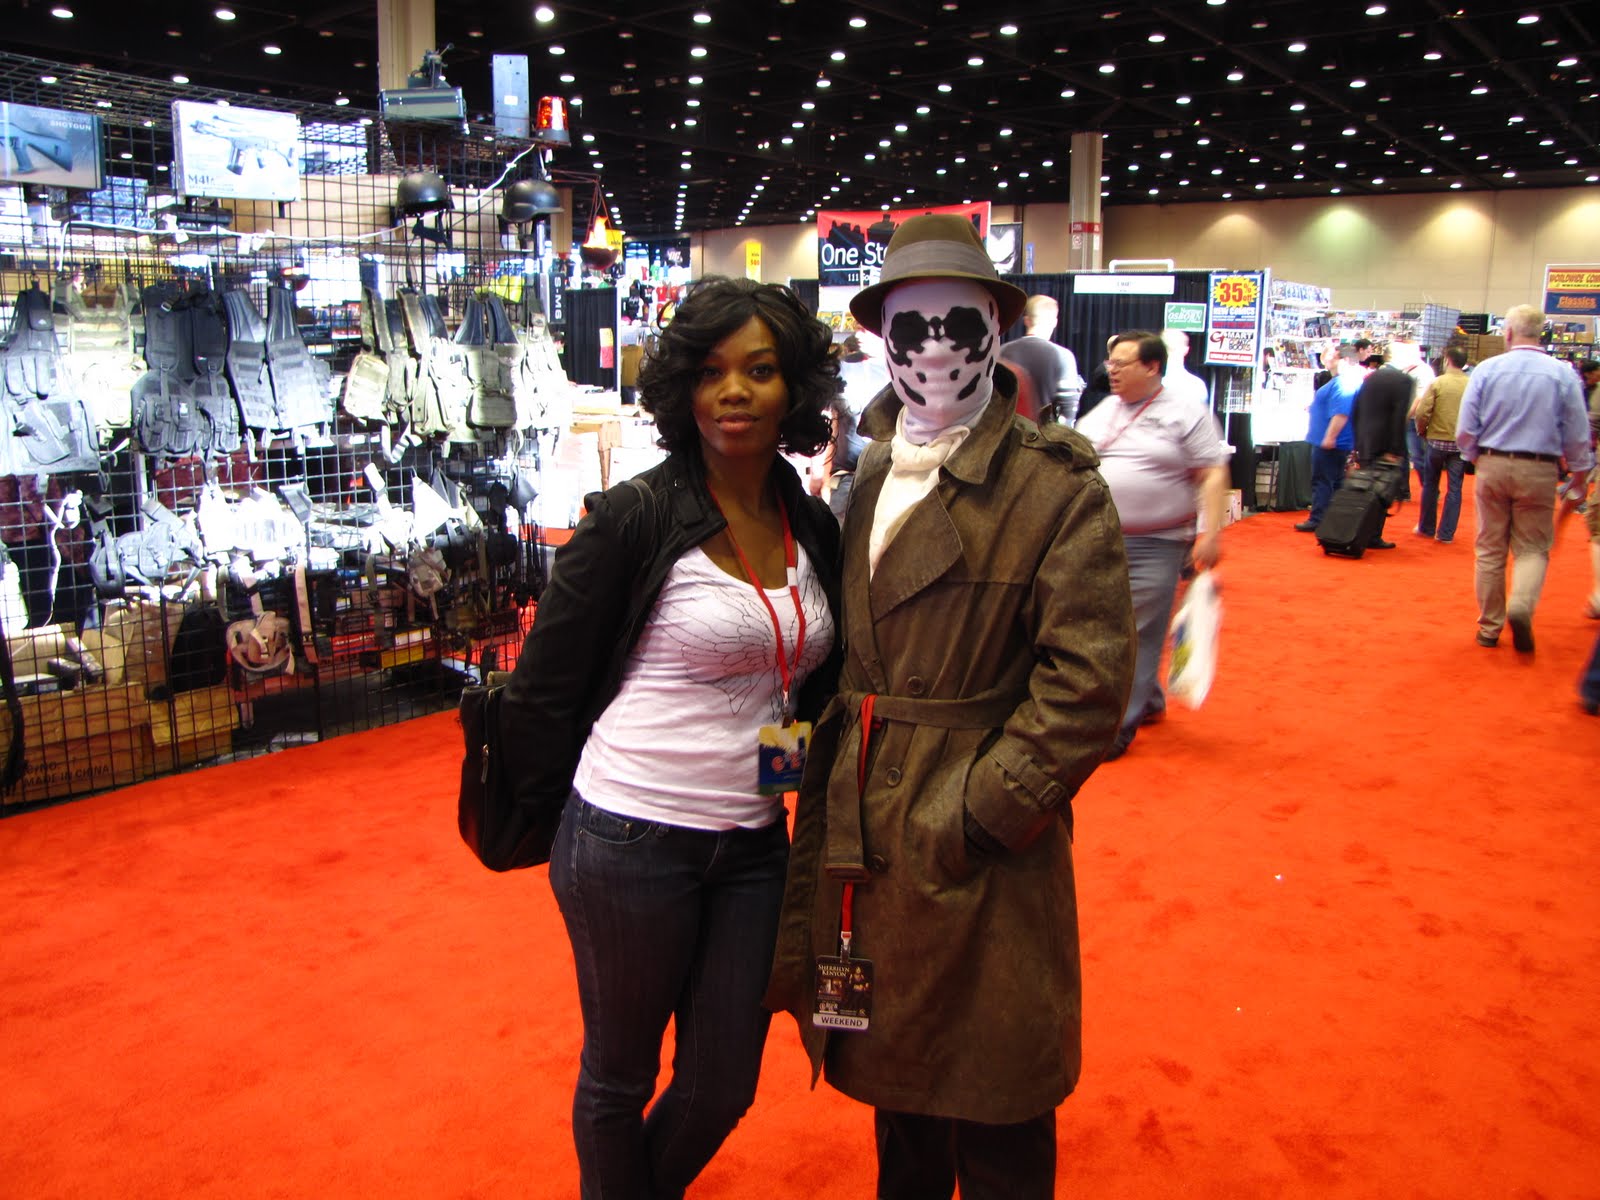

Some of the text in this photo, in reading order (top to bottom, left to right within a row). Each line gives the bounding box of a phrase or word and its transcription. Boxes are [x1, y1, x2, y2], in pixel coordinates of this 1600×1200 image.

[50, 120, 92, 131] SHOTGUN
[821, 243, 859, 266] One
[847, 273, 859, 282] 111
[25, 764, 109, 786] MADE IN CHINA
[821, 1016, 863, 1027] WEEKEND
